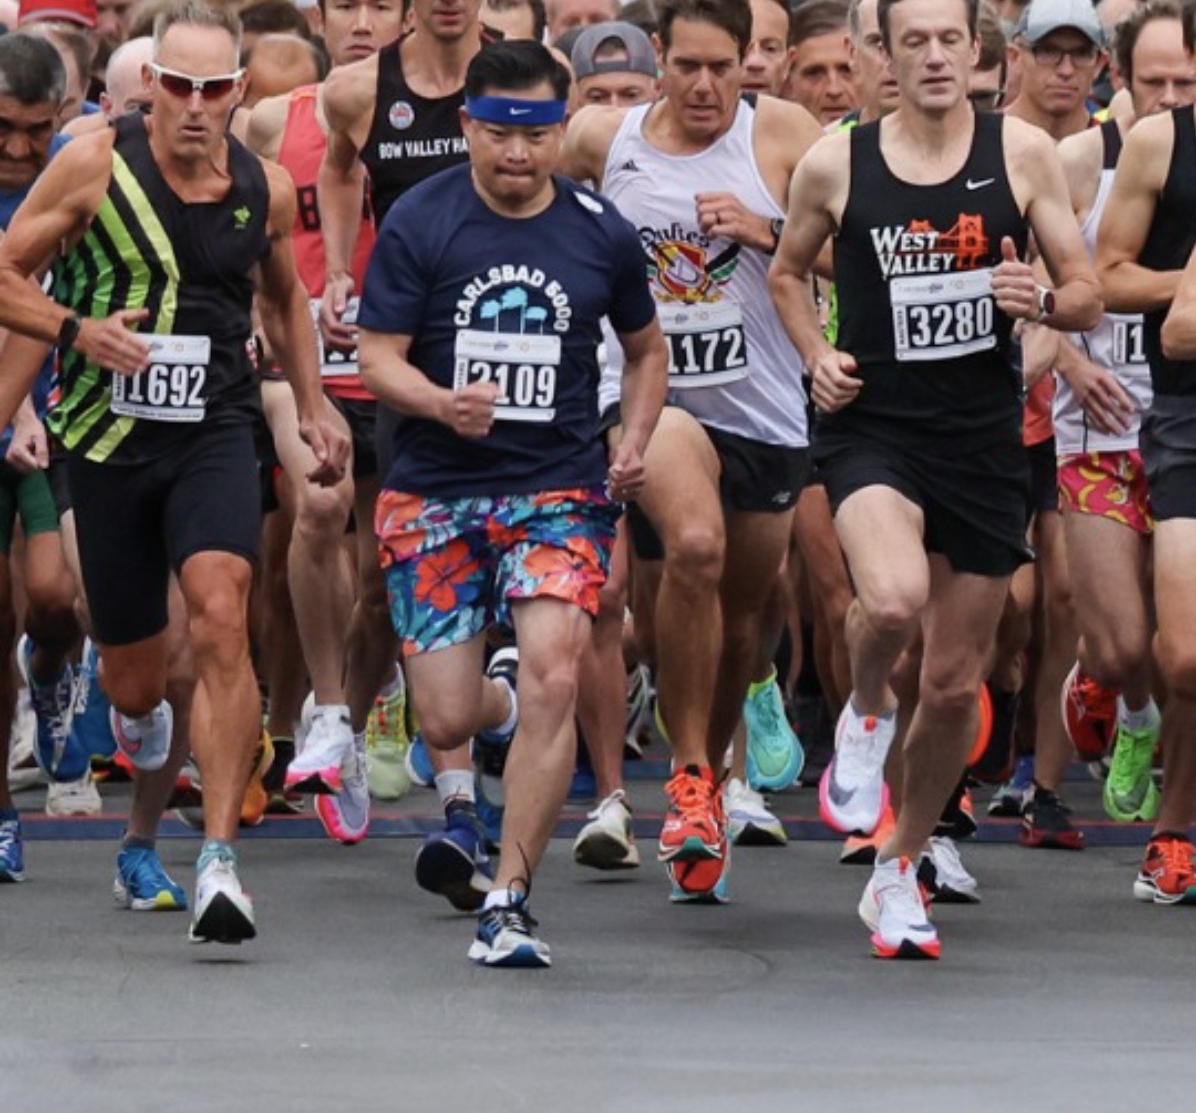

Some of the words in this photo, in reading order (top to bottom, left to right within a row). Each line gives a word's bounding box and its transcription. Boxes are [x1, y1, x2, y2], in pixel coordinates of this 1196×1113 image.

[379, 142, 403, 159] BOW
[405, 138, 450, 158] VALLEY
[870, 226, 940, 255] WEST
[878, 252, 957, 281] VALLEY
[454, 264, 546, 326] CARLSBAD
[544, 280, 572, 332] 5000
[909, 296, 994, 347] 3280
[128, 362, 207, 407] 1692
